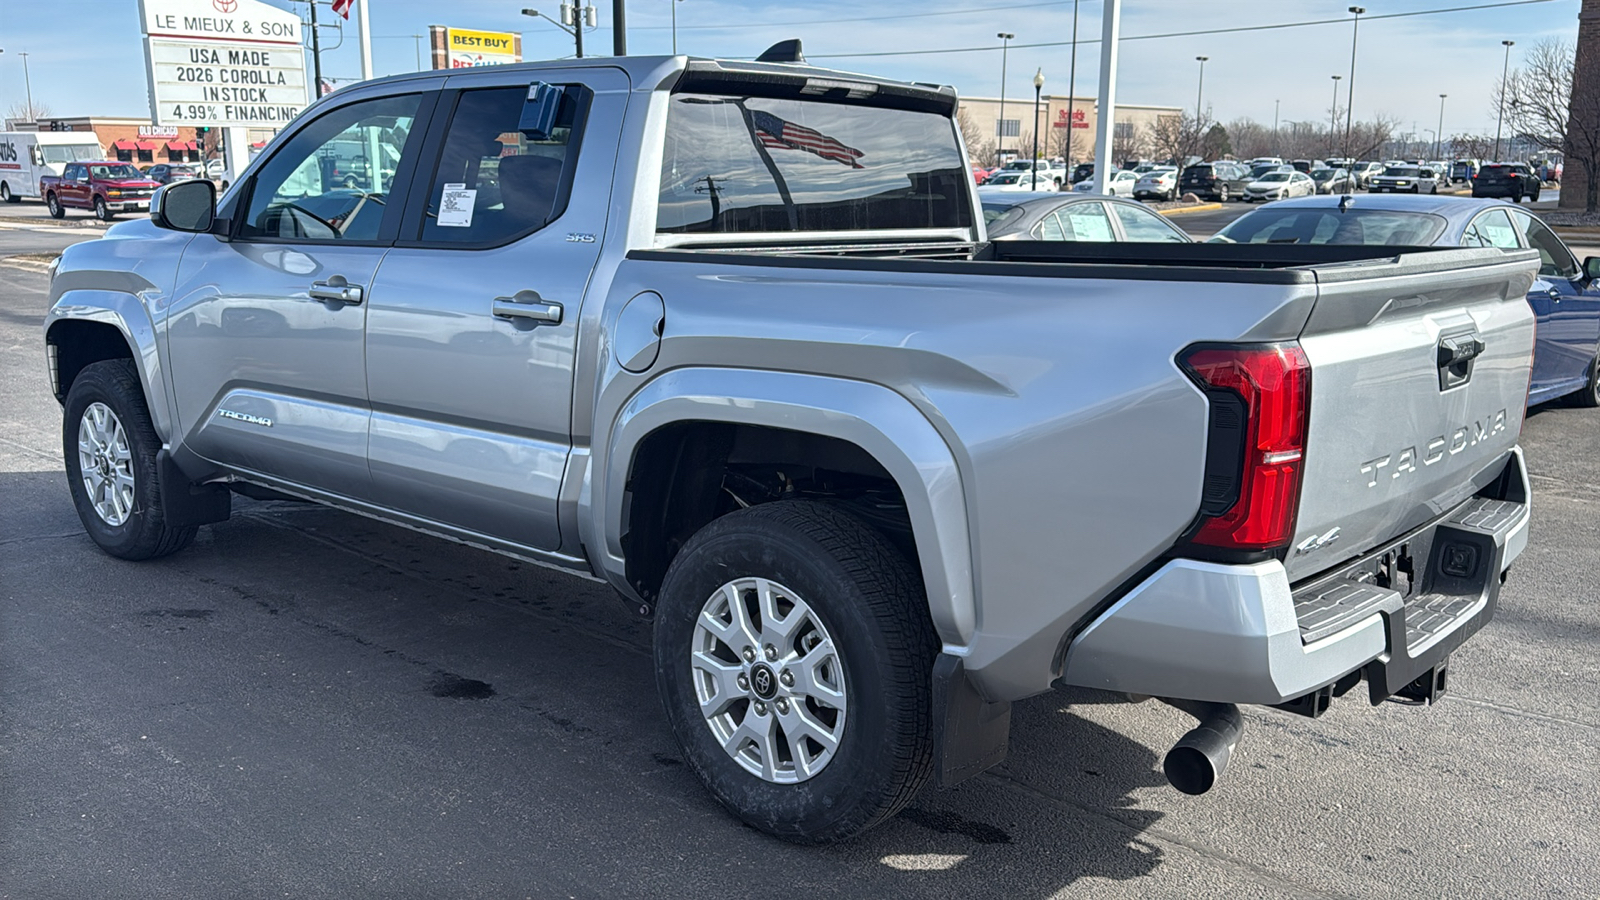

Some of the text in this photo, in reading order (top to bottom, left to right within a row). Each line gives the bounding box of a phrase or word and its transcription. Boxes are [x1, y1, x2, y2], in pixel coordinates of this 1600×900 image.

[155, 14, 294, 37] LE MIEUX & SON
[453, 35, 509, 48] BEST BUY
[190, 48, 270, 66] USA MADE
[176, 66, 286, 86] 2026 COROLLA
[173, 104, 299, 121] 4.99% FINANCING
[139, 125, 178, 136] OLD CHICAGO
[218, 408, 272, 427] TACOMA
[1360, 408, 1507, 488] TACOMA
